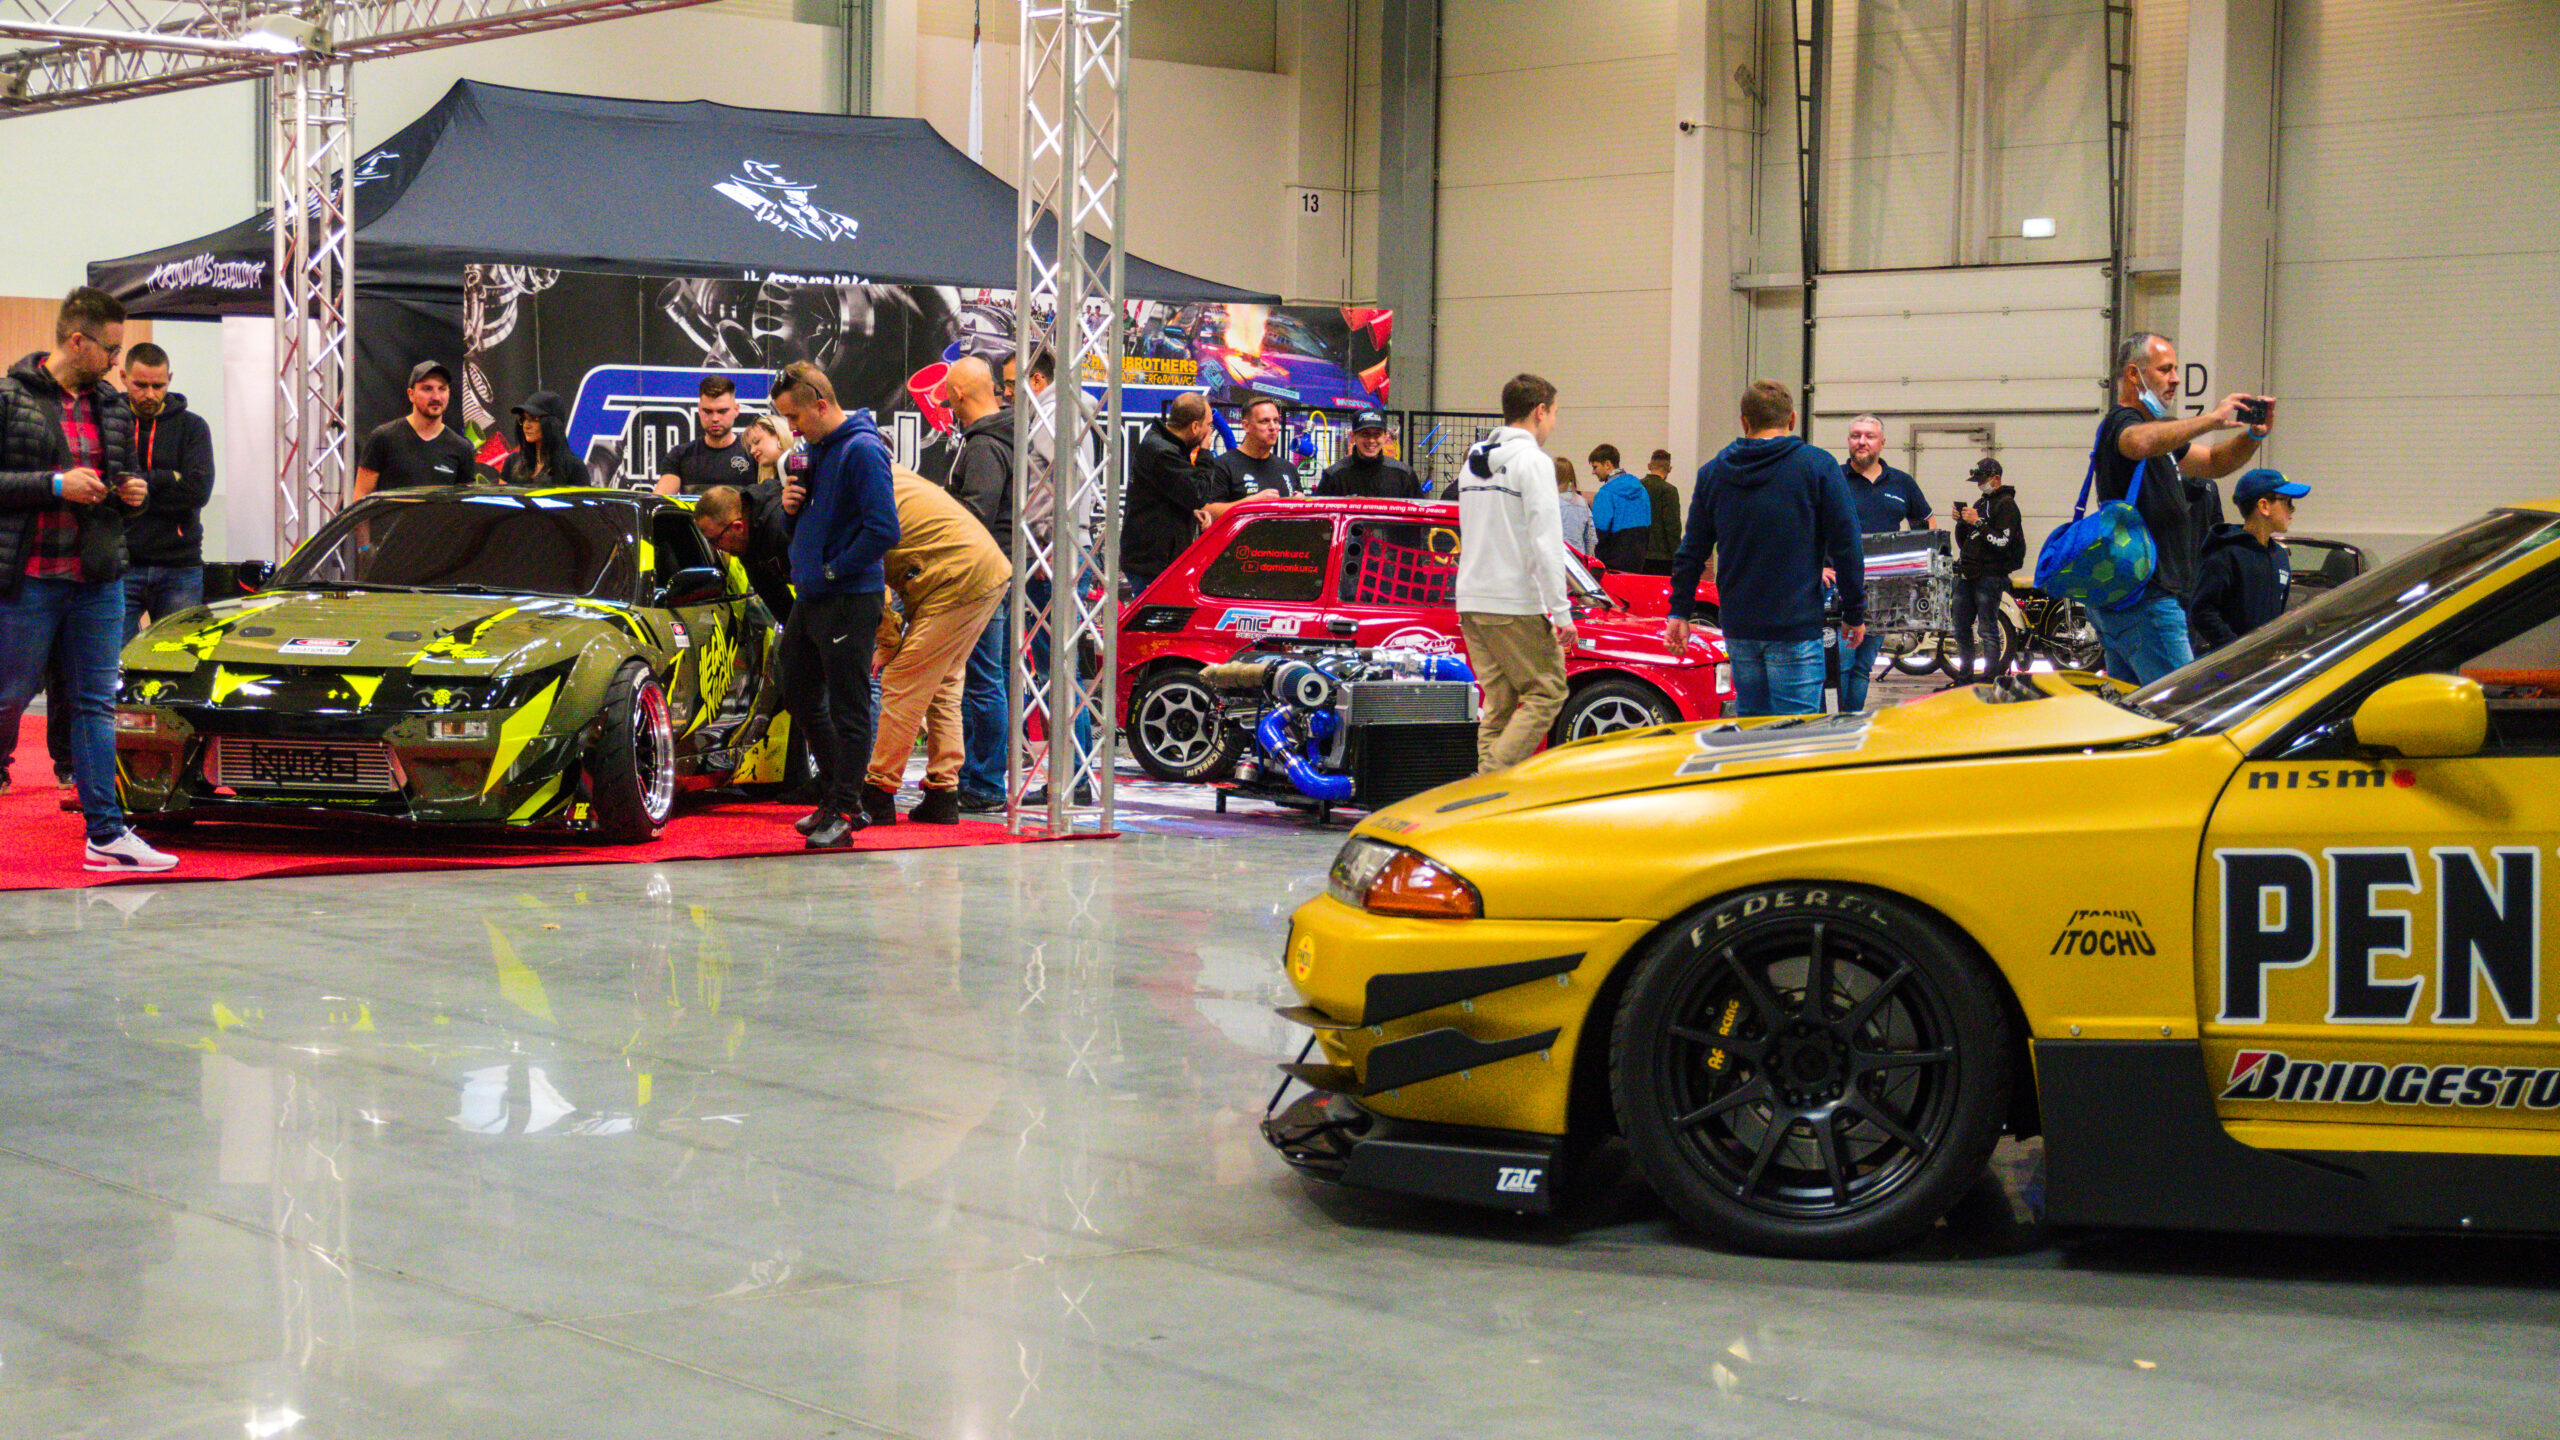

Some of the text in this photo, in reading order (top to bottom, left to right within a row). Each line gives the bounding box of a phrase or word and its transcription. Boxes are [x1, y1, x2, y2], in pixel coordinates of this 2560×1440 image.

[1301, 193, 1319, 212] 13
[2185, 363, 2208, 397] D
[2049, 930, 2156, 956] ITOCHU
[2213, 846, 2560, 1025] PEN
[1496, 1167, 1543, 1191] TAC
